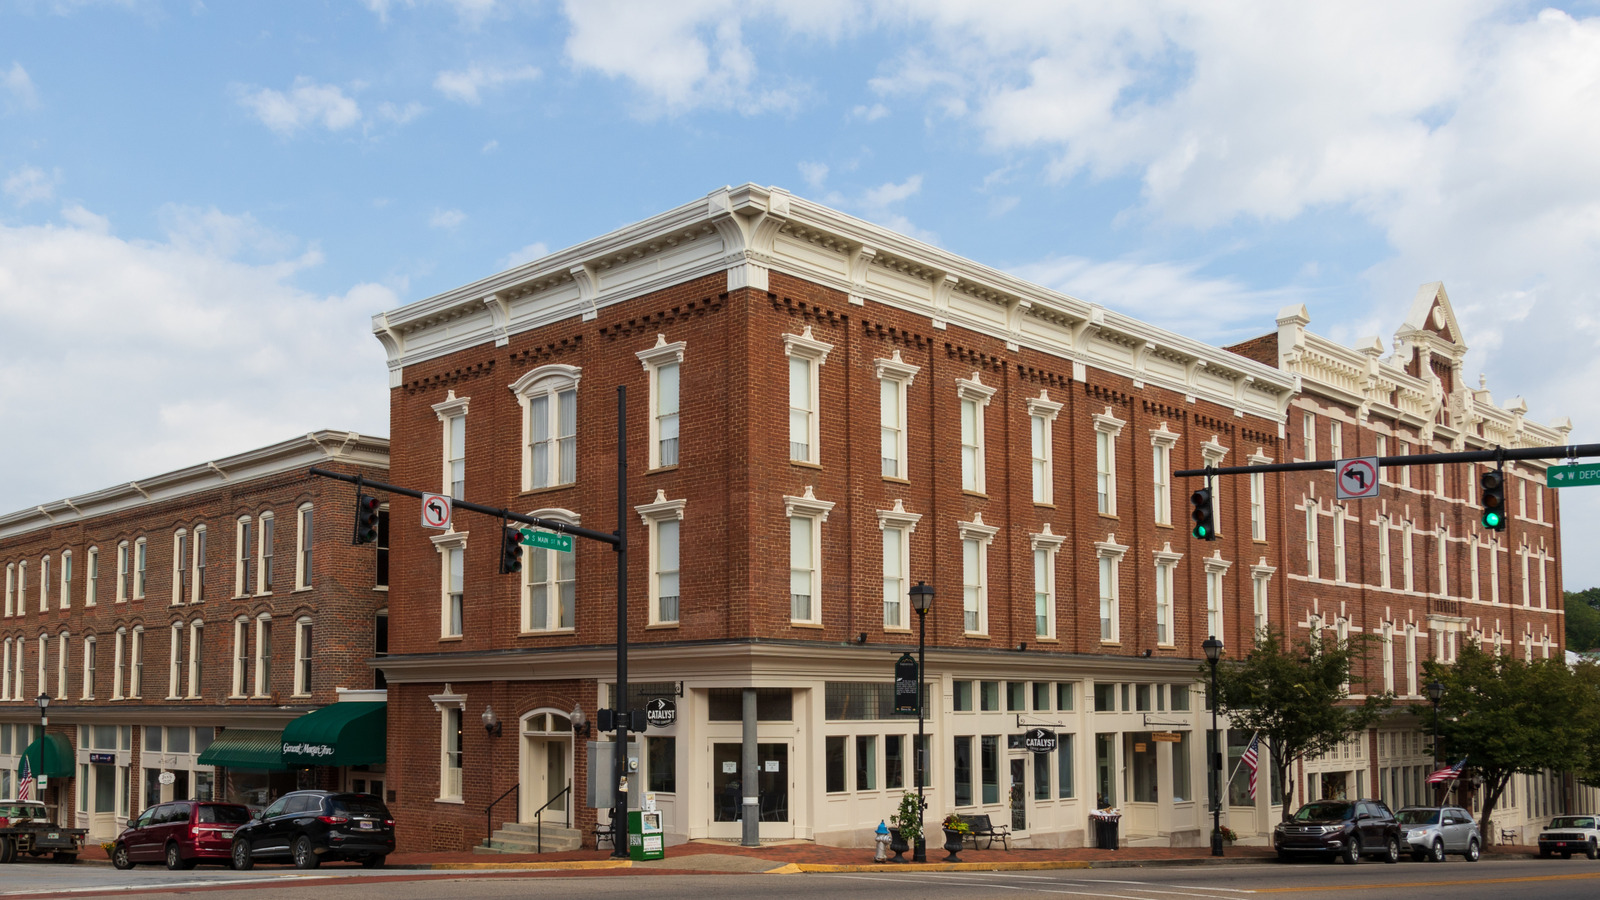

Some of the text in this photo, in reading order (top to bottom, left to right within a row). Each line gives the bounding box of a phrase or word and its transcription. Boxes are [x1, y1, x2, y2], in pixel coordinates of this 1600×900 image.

[1568, 471, 1575, 480] W
[647, 709, 675, 719] CATALYST
[1026, 738, 1055, 747] CATALYST
[282, 742, 304, 756] General
[318, 744, 335, 757] Inn
